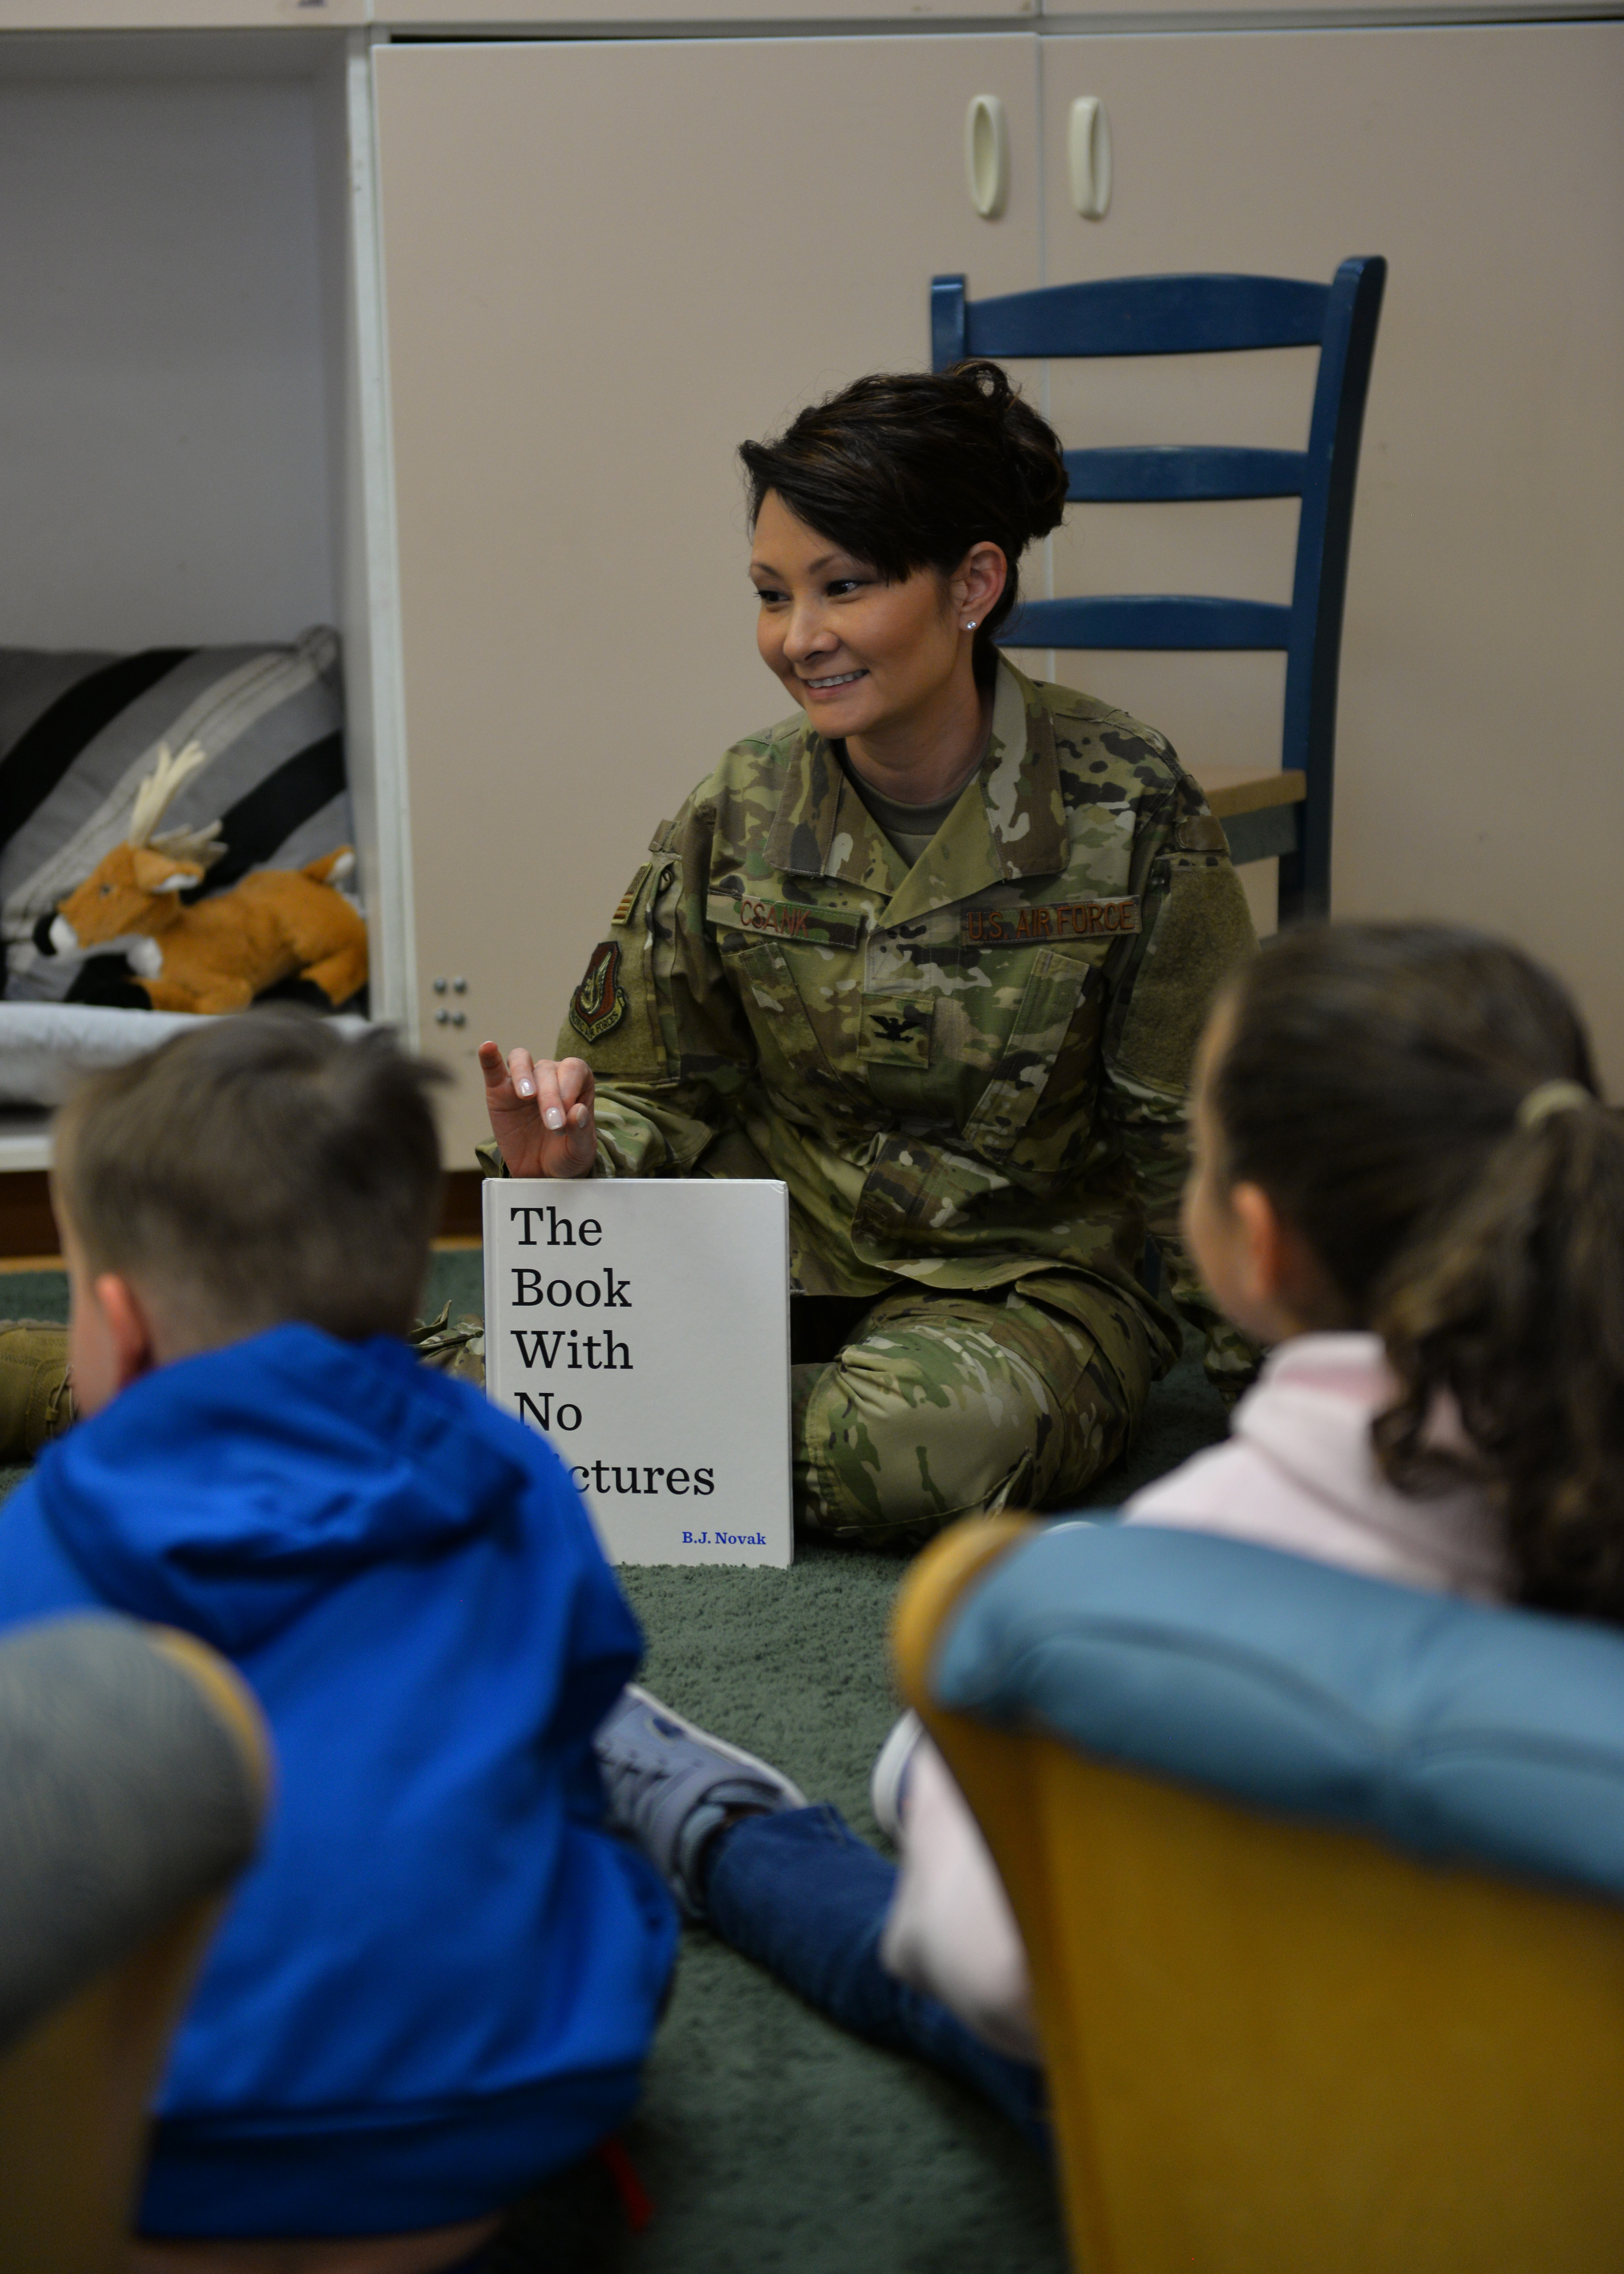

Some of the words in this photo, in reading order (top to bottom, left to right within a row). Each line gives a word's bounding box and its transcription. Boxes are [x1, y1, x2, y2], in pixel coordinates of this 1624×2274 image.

[740, 900, 811, 938] CSANK
[968, 911, 1008, 940] U.S.
[1016, 908, 1050, 939] AIR
[1057, 901, 1134, 935] FORCE
[511, 1206, 602, 1246] The
[512, 1268, 632, 1307] Book
[511, 1330, 634, 1370] With
[514, 1392, 582, 1431] No
[553, 1453, 715, 1496] ctures
[682, 1531, 711, 1544] B.J.
[715, 1532, 767, 1546] Novak
